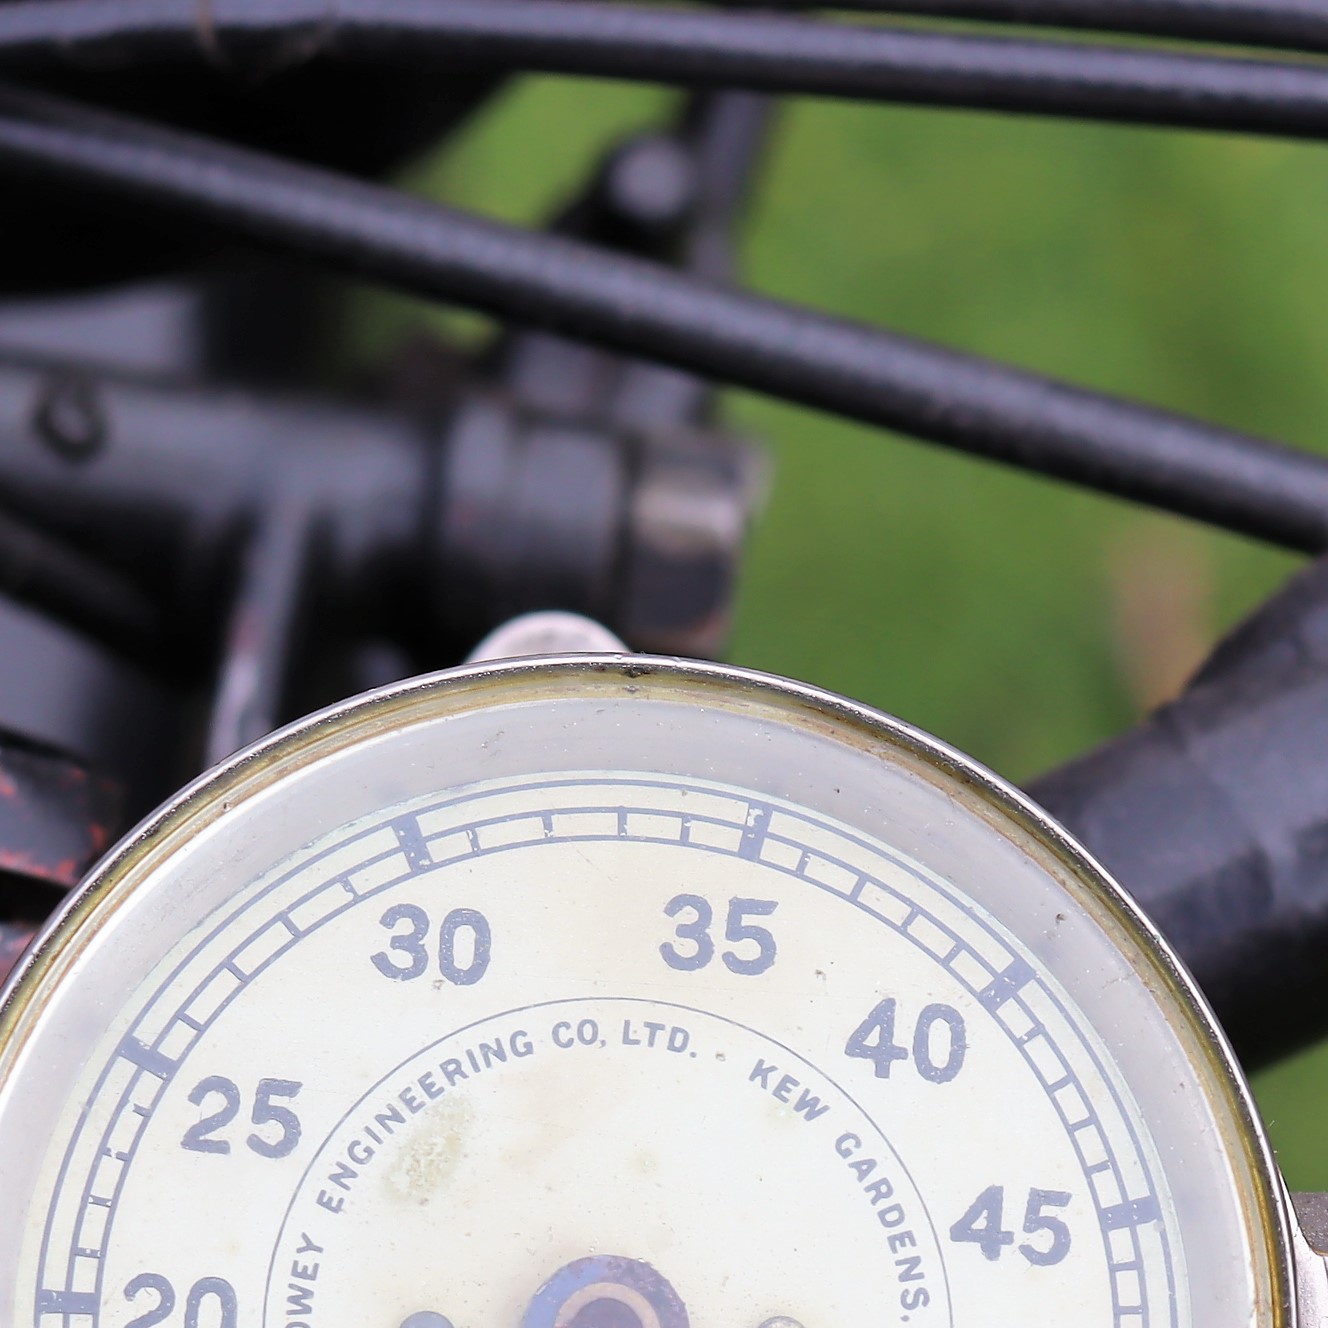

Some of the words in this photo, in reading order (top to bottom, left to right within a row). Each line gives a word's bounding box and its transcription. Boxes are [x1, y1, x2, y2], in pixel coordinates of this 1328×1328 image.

[371, 904, 491, 986] 30
[659, 894, 779, 976] 35
[844, 997, 968, 1084] 40
[180, 1076, 303, 1158] 25
[316, 1029, 534, 1214] ENGINEERING
[622, 1019, 697, 1058] LTD.
[749, 1058, 830, 1122] KEW
[949, 1185, 1072, 1267] 45
